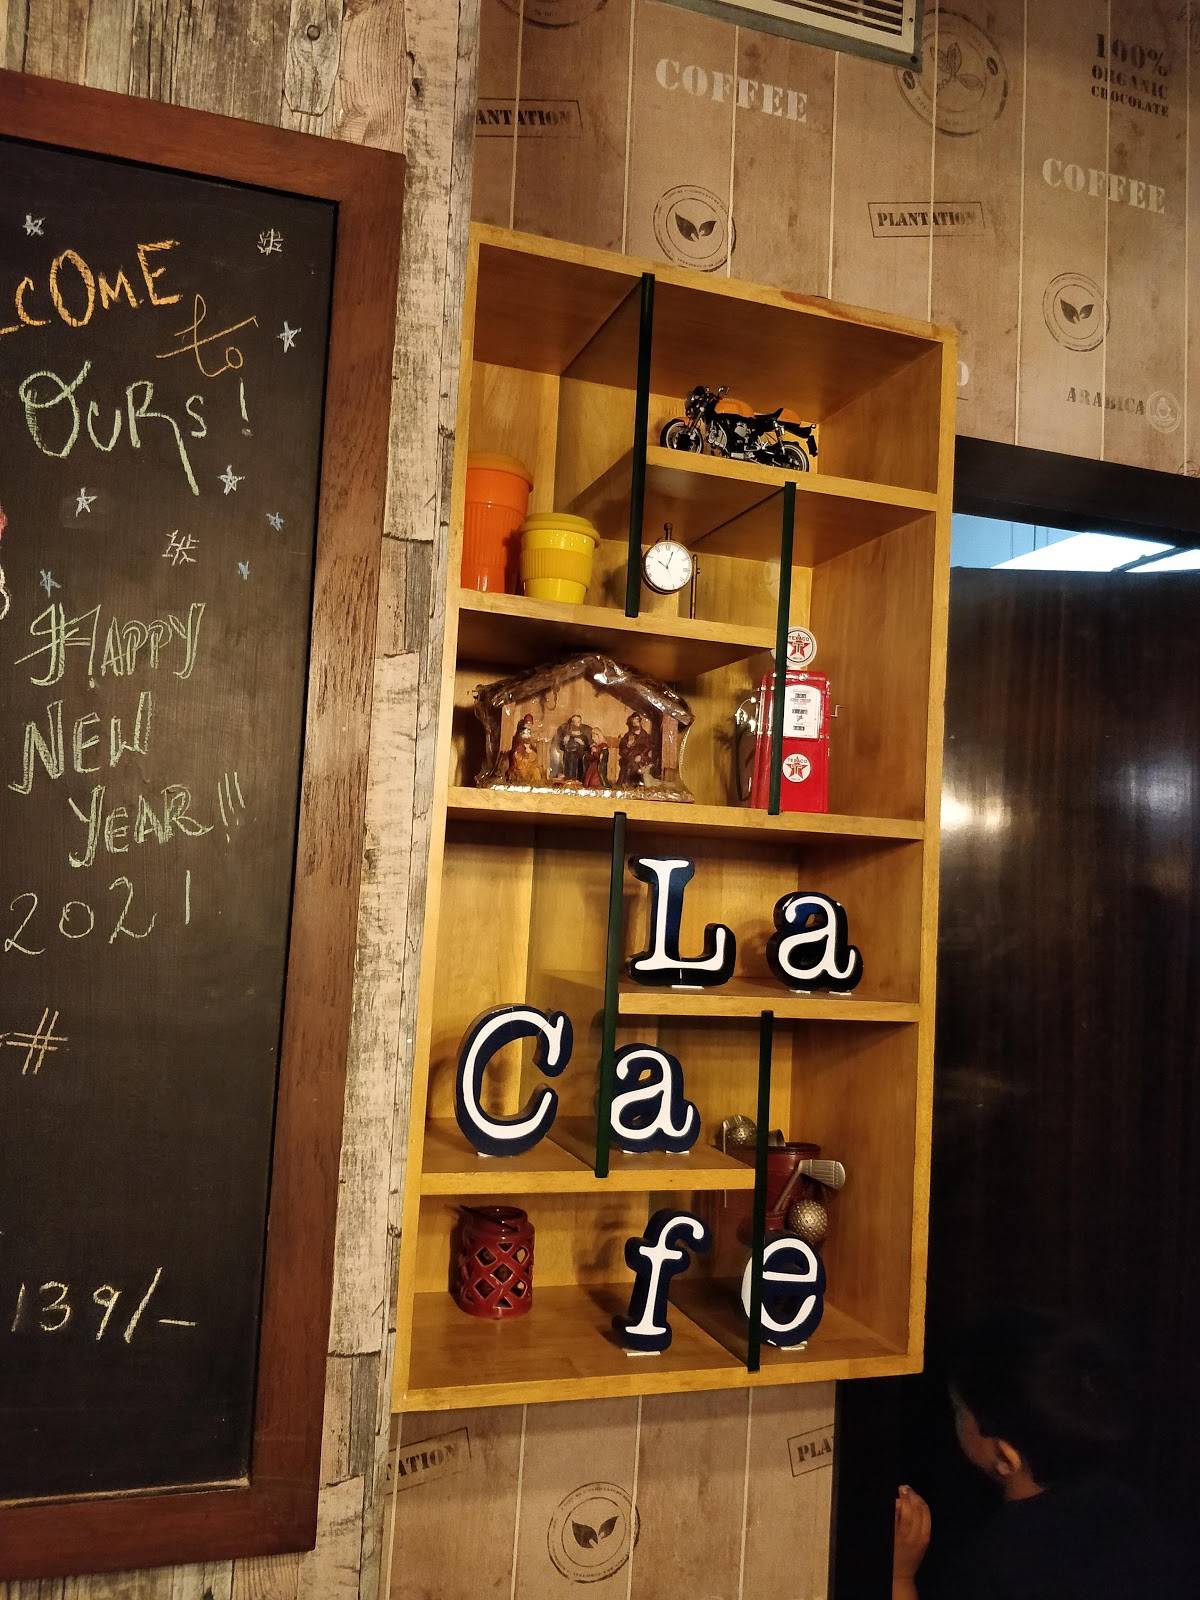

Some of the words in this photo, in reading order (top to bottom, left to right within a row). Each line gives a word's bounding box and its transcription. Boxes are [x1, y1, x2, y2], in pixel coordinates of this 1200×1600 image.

[655, 57, 808, 124] COFFEE
[1091, 86, 1169, 117] CHOCOLATE
[1042, 158, 1166, 215] COFFEE
[0, 240, 181, 335] COME
[1066, 387, 1145, 416] ARABICA
[8, 691, 152, 795] NEW
[4, 869, 191, 955] 2021
